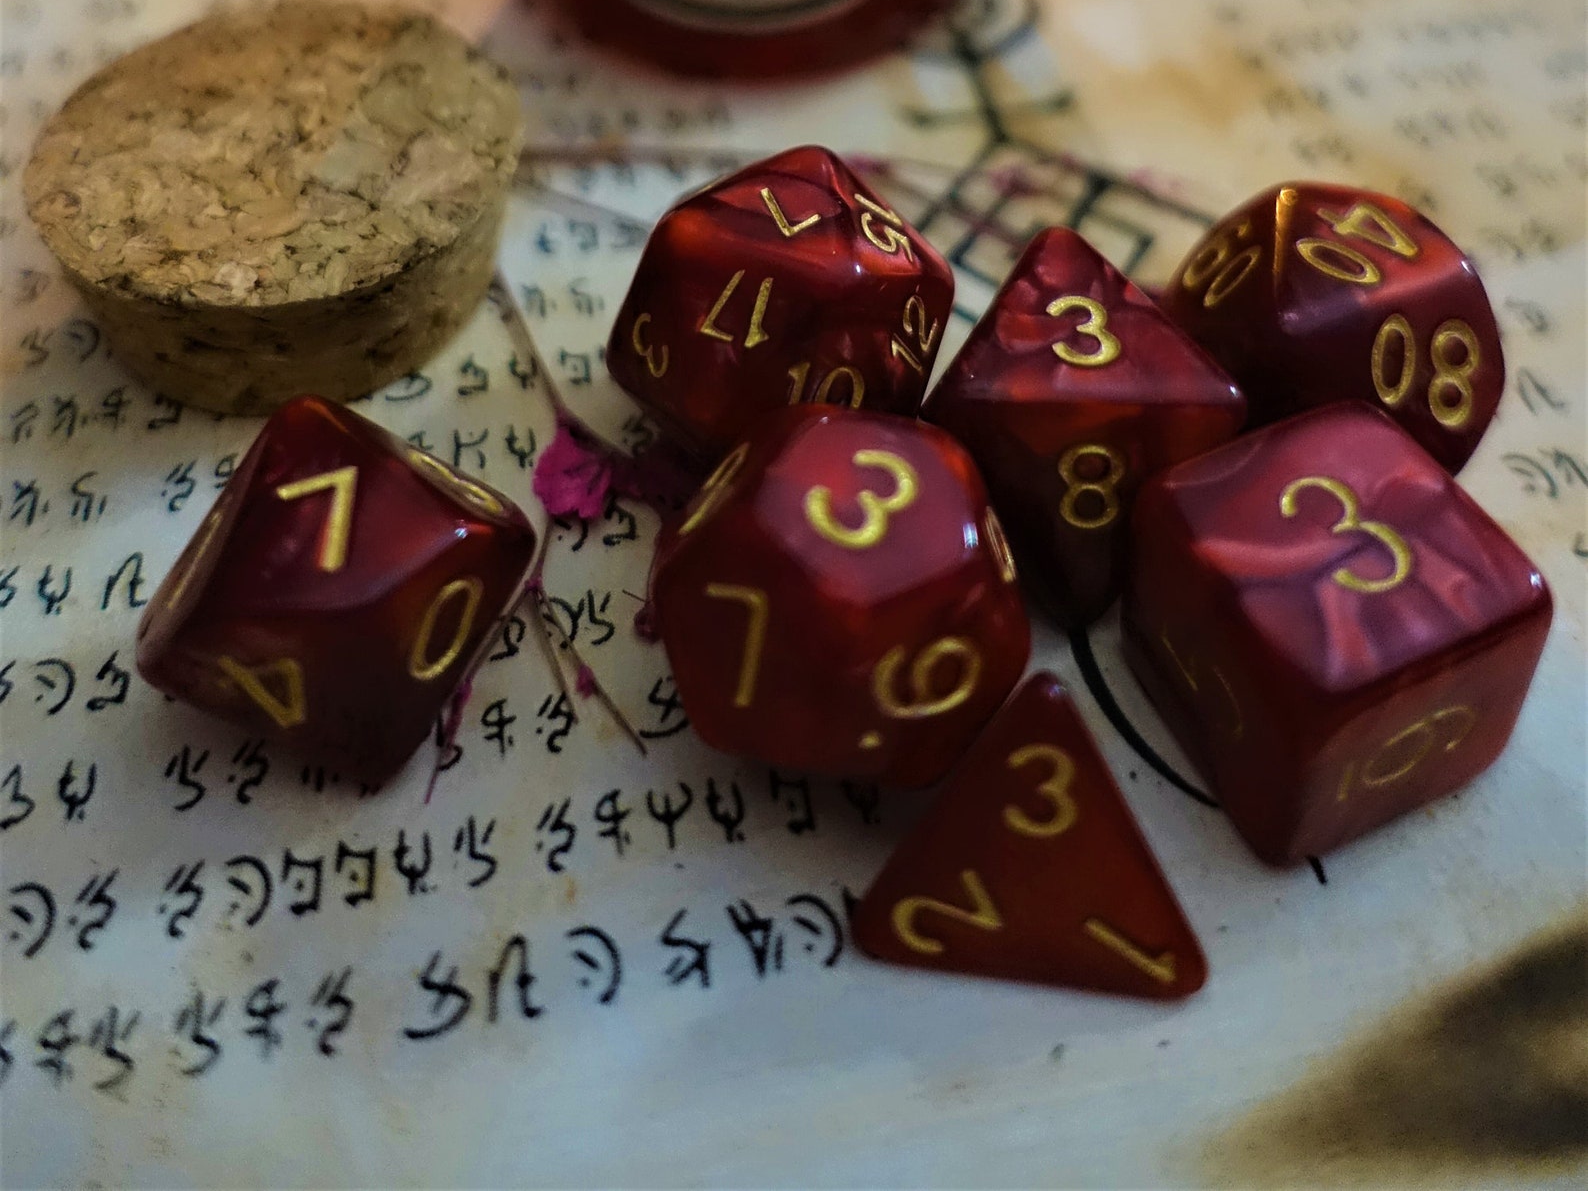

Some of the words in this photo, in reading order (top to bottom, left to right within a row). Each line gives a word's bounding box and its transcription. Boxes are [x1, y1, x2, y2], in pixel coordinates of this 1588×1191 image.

[855, 193, 915, 262] 15
[1296, 205, 1418, 285] 40
[632, 312, 670, 378] 3
[700, 269, 773, 349] 17
[891, 295, 938, 371] 12
[1046, 296, 1121, 366] 3
[788, 362, 866, 409] 10
[1371, 313, 1480, 429] 80
[277, 465, 358, 572] 7
[805, 449, 919, 549] 3
[1058, 444, 1126, 529] 8
[1281, 476, 1411, 593] 3
[408, 577, 485, 681] 0
[705, 582, 768, 707] 7
[1004, 743, 1077, 838] 3
[891, 870, 1002, 954] 2
[1084, 918, 1176, 982] 1
